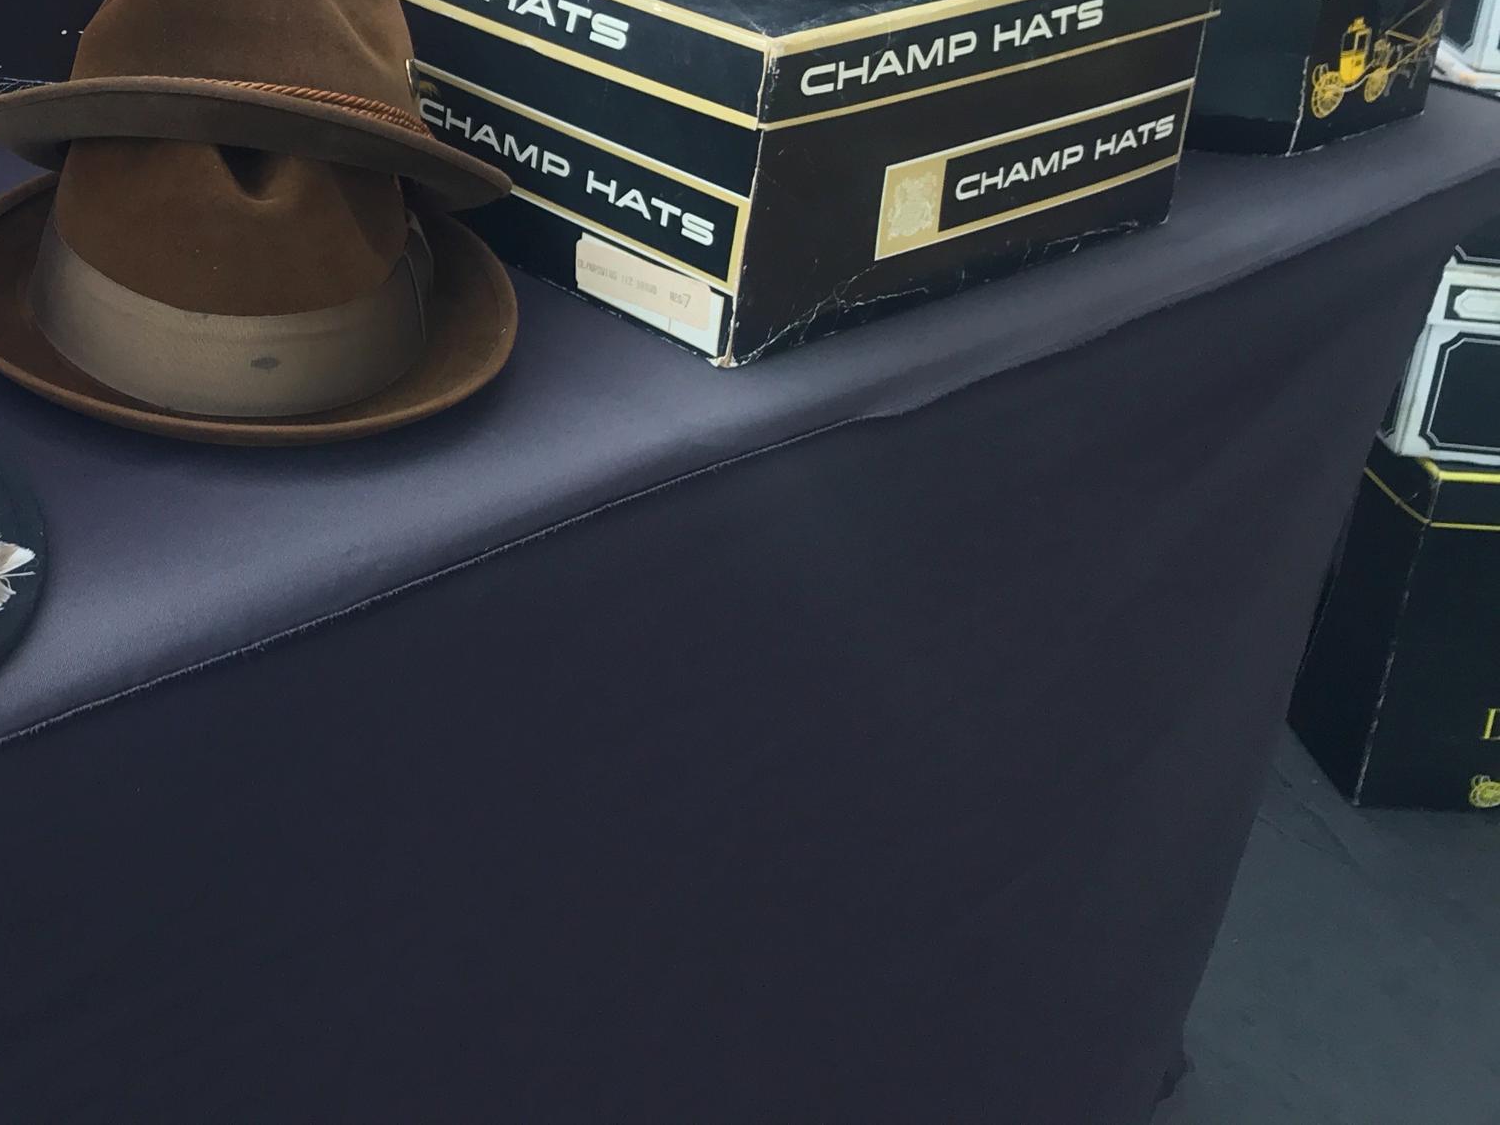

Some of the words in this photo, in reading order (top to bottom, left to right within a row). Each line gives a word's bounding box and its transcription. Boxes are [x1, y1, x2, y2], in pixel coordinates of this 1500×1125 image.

[800, 30, 978, 97] CHAMP
[418, 97, 572, 178] CHAMP
[585, 169, 716, 247] HATS
[955, 144, 1085, 202] CHAMP
[1094, 113, 1176, 162] HATS
